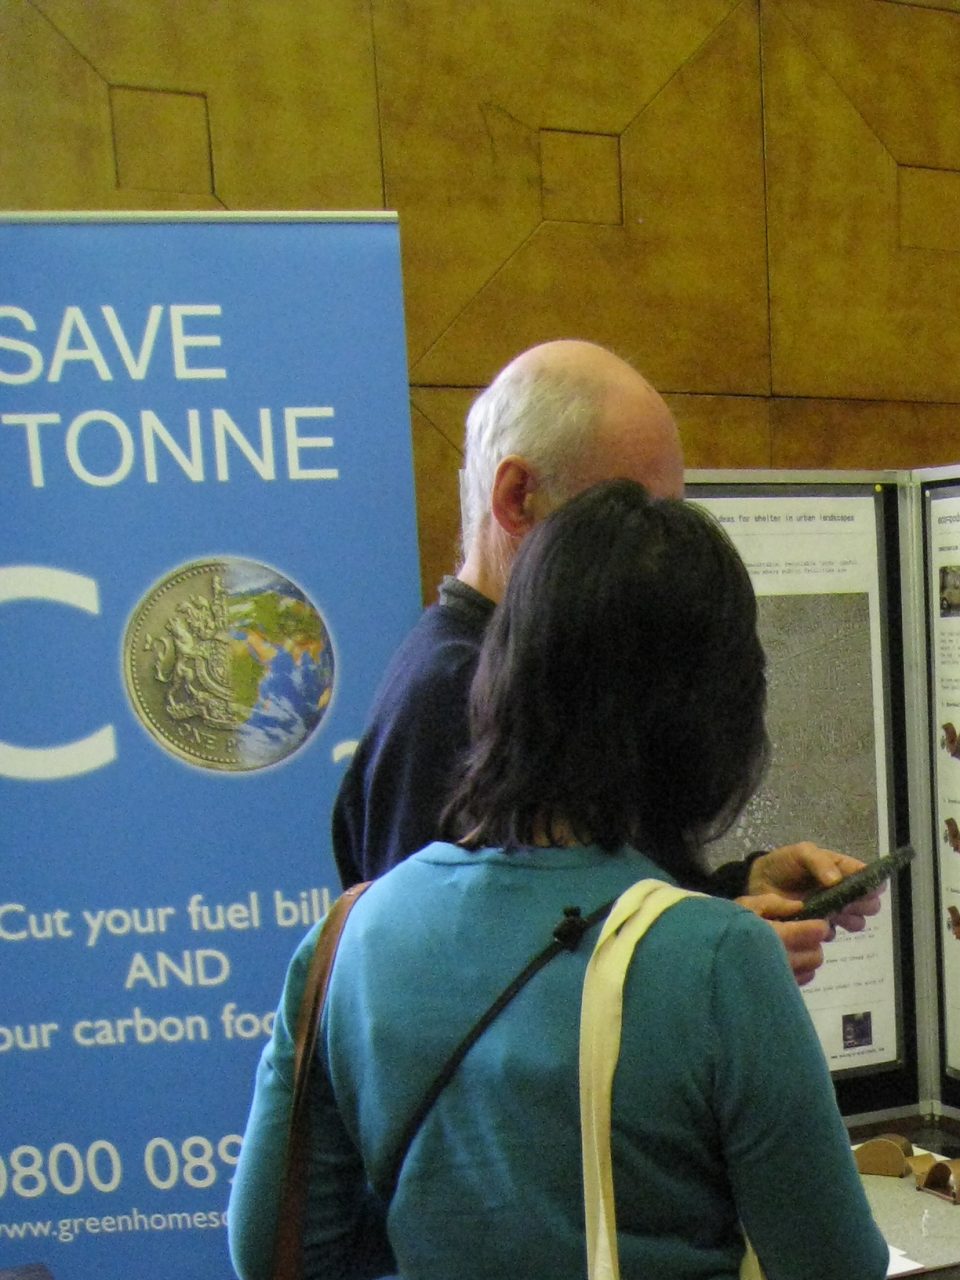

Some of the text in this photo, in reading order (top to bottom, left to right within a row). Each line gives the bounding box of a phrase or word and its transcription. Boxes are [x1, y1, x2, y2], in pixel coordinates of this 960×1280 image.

[0, 304, 227, 385] SAVE
[1, 406, 340, 488] TONNE
[738, 514, 750, 523] for
[754, 514, 782, 523] shelter
[785, 514, 794, 522] in
[796, 514, 816, 522] urban
[819, 513, 856, 523] landscapes
[0, 887, 332, 947] Cut your fuel bill
[125, 949, 230, 989] AND
[0, 1022, 59, 1051] our
[73, 1006, 209, 1047] carbon
[0, 1139, 122, 1199] 800
